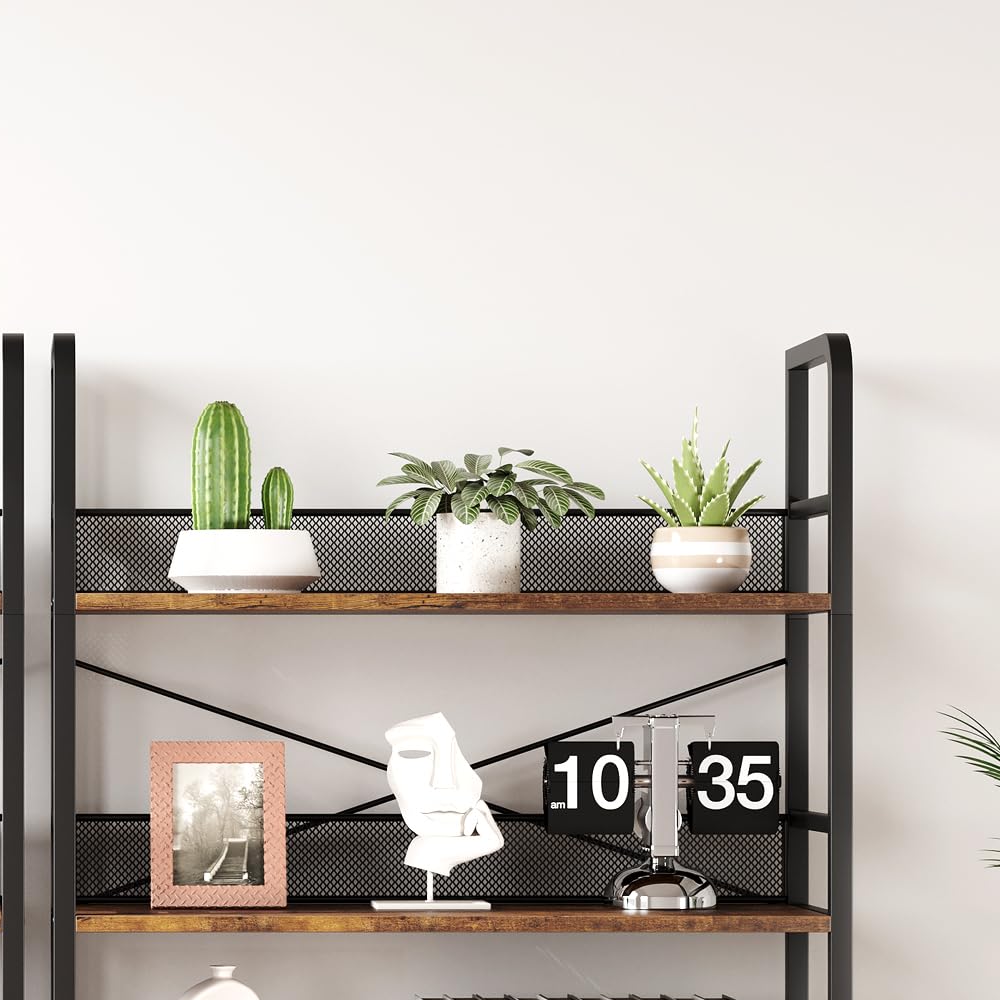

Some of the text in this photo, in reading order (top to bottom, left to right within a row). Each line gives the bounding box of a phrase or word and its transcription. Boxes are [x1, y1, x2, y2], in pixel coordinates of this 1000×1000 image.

[550, 801, 565, 809] am
[554, 754, 629, 810] 10
[698, 754, 774, 810] 35
